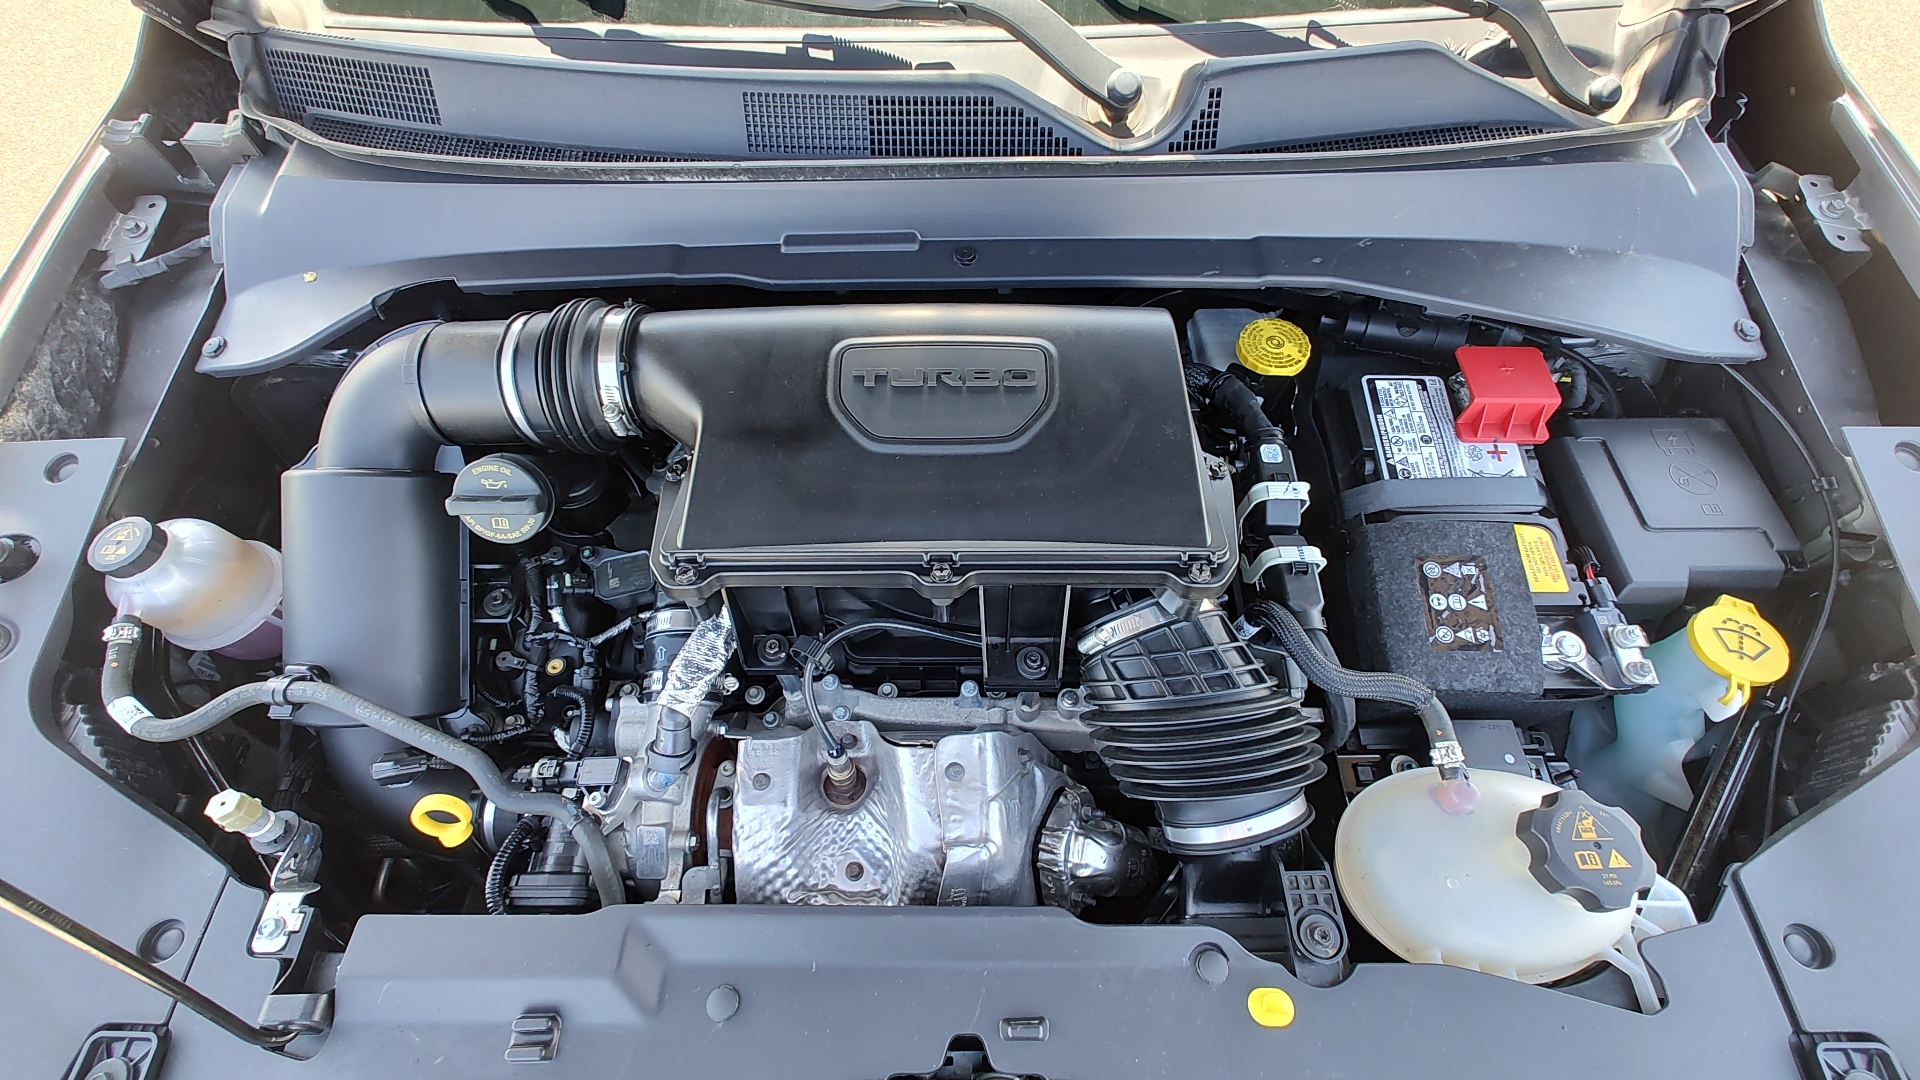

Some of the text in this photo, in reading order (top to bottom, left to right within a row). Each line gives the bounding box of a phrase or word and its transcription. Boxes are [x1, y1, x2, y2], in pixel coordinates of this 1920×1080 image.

[852, 367, 1037, 388] TURBO
[471, 464, 512, 477] ENGINE OIL
[464, 515, 475, 526] API
[1517, 532, 1529, 552] BATTERY
[1528, 564, 1539, 582] SEALED
[108, 646, 118, 660] BTL
